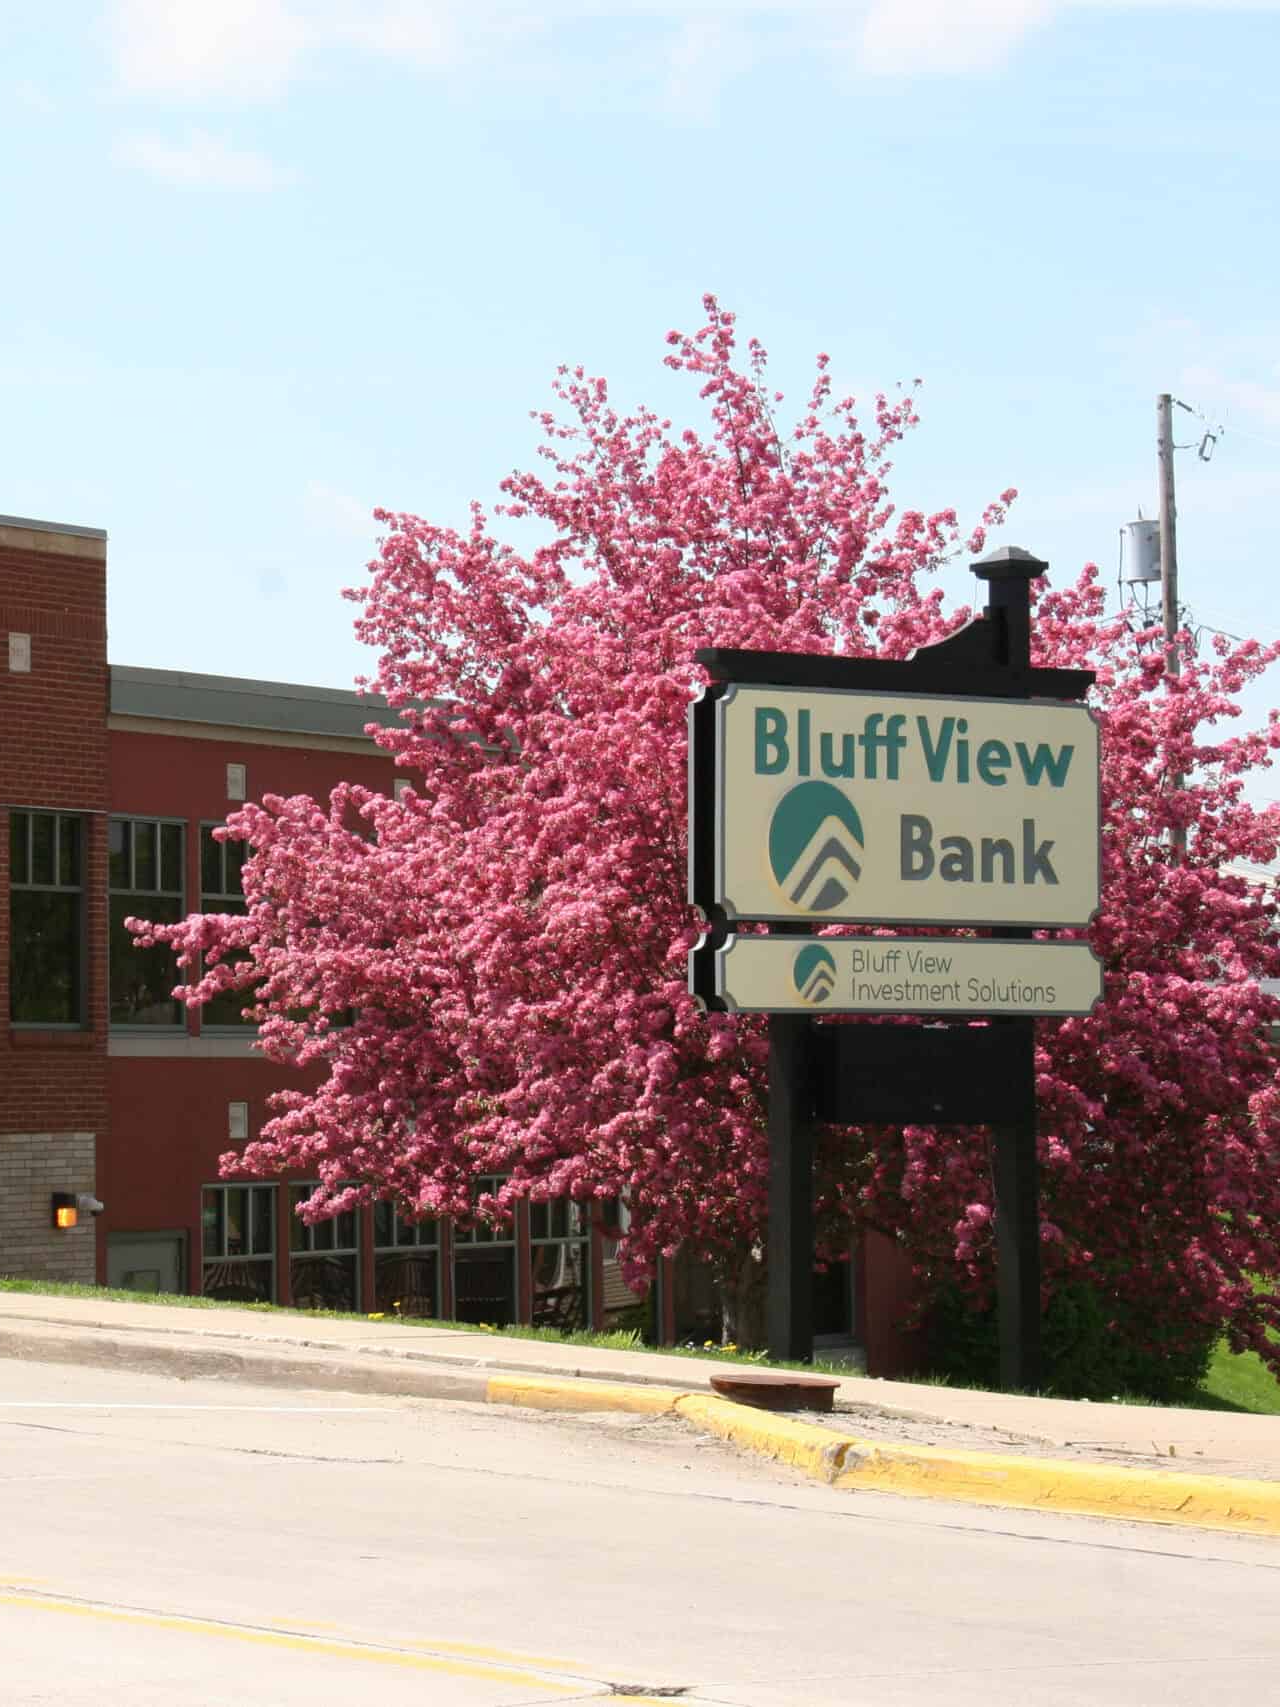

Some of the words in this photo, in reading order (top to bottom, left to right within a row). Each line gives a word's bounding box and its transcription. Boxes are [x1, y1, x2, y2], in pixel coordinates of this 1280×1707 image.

[754, 707, 907, 780] Bluff
[917, 716, 1074, 787] View
[900, 814, 1060, 884] Bank
[851, 949, 900, 973] Bluff
[906, 952, 952, 974] View
[851, 978, 962, 1001] Investment
[967, 979, 1055, 1003] Solutions
